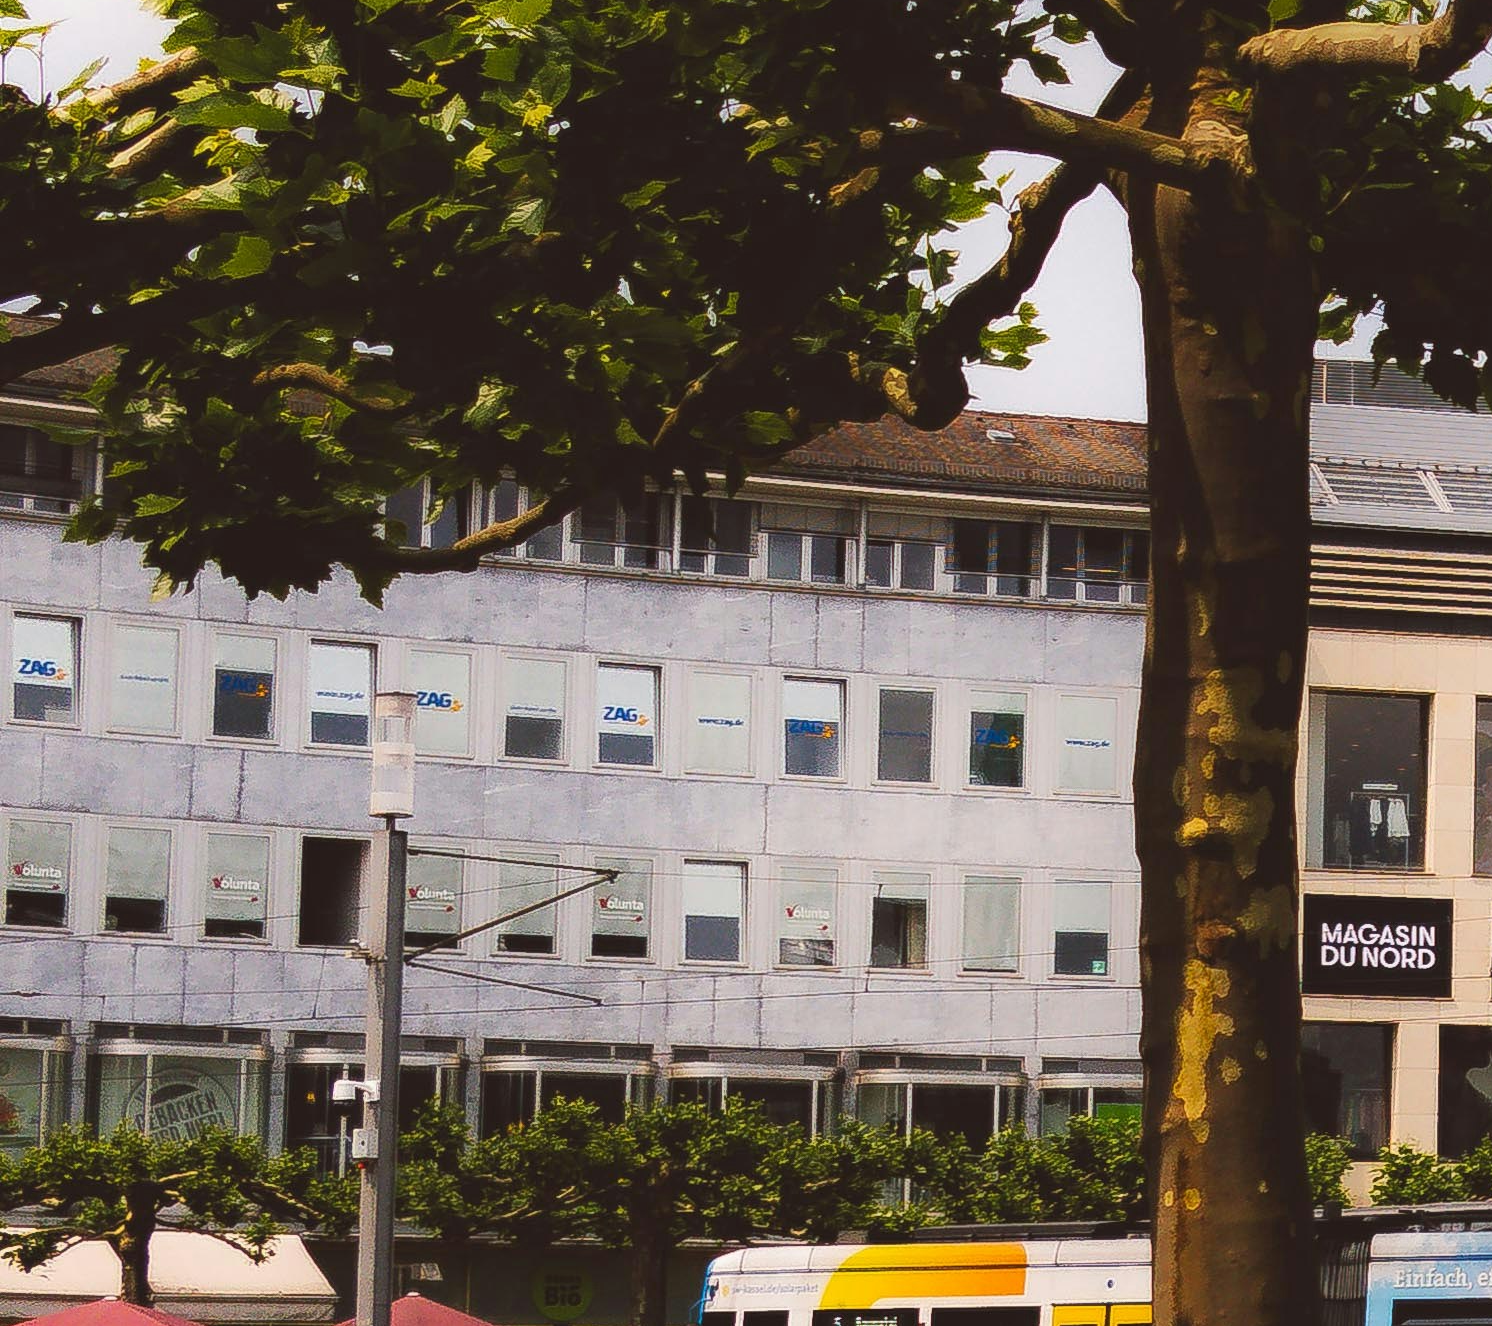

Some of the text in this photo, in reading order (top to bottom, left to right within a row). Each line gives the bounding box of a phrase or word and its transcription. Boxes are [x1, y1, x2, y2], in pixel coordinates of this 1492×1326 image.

[17, 658, 56, 677] ZAG
[416, 691, 452, 708] ZAG
[602, 705, 639, 723] ZAG
[12, 862, 63, 879] Volunta
[212, 875, 261, 891] Volunta
[408, 885, 456, 902] Volunta
[599, 895, 645, 912] Volunta
[784, 903, 831, 921] Volunta
[1321, 922, 1436, 947] MAGASIN
[1320, 945, 1436, 970] DU NORD
[1393, 1266, 1474, 1290] Einfach,
[544, 1285, 582, 1307] Bio
